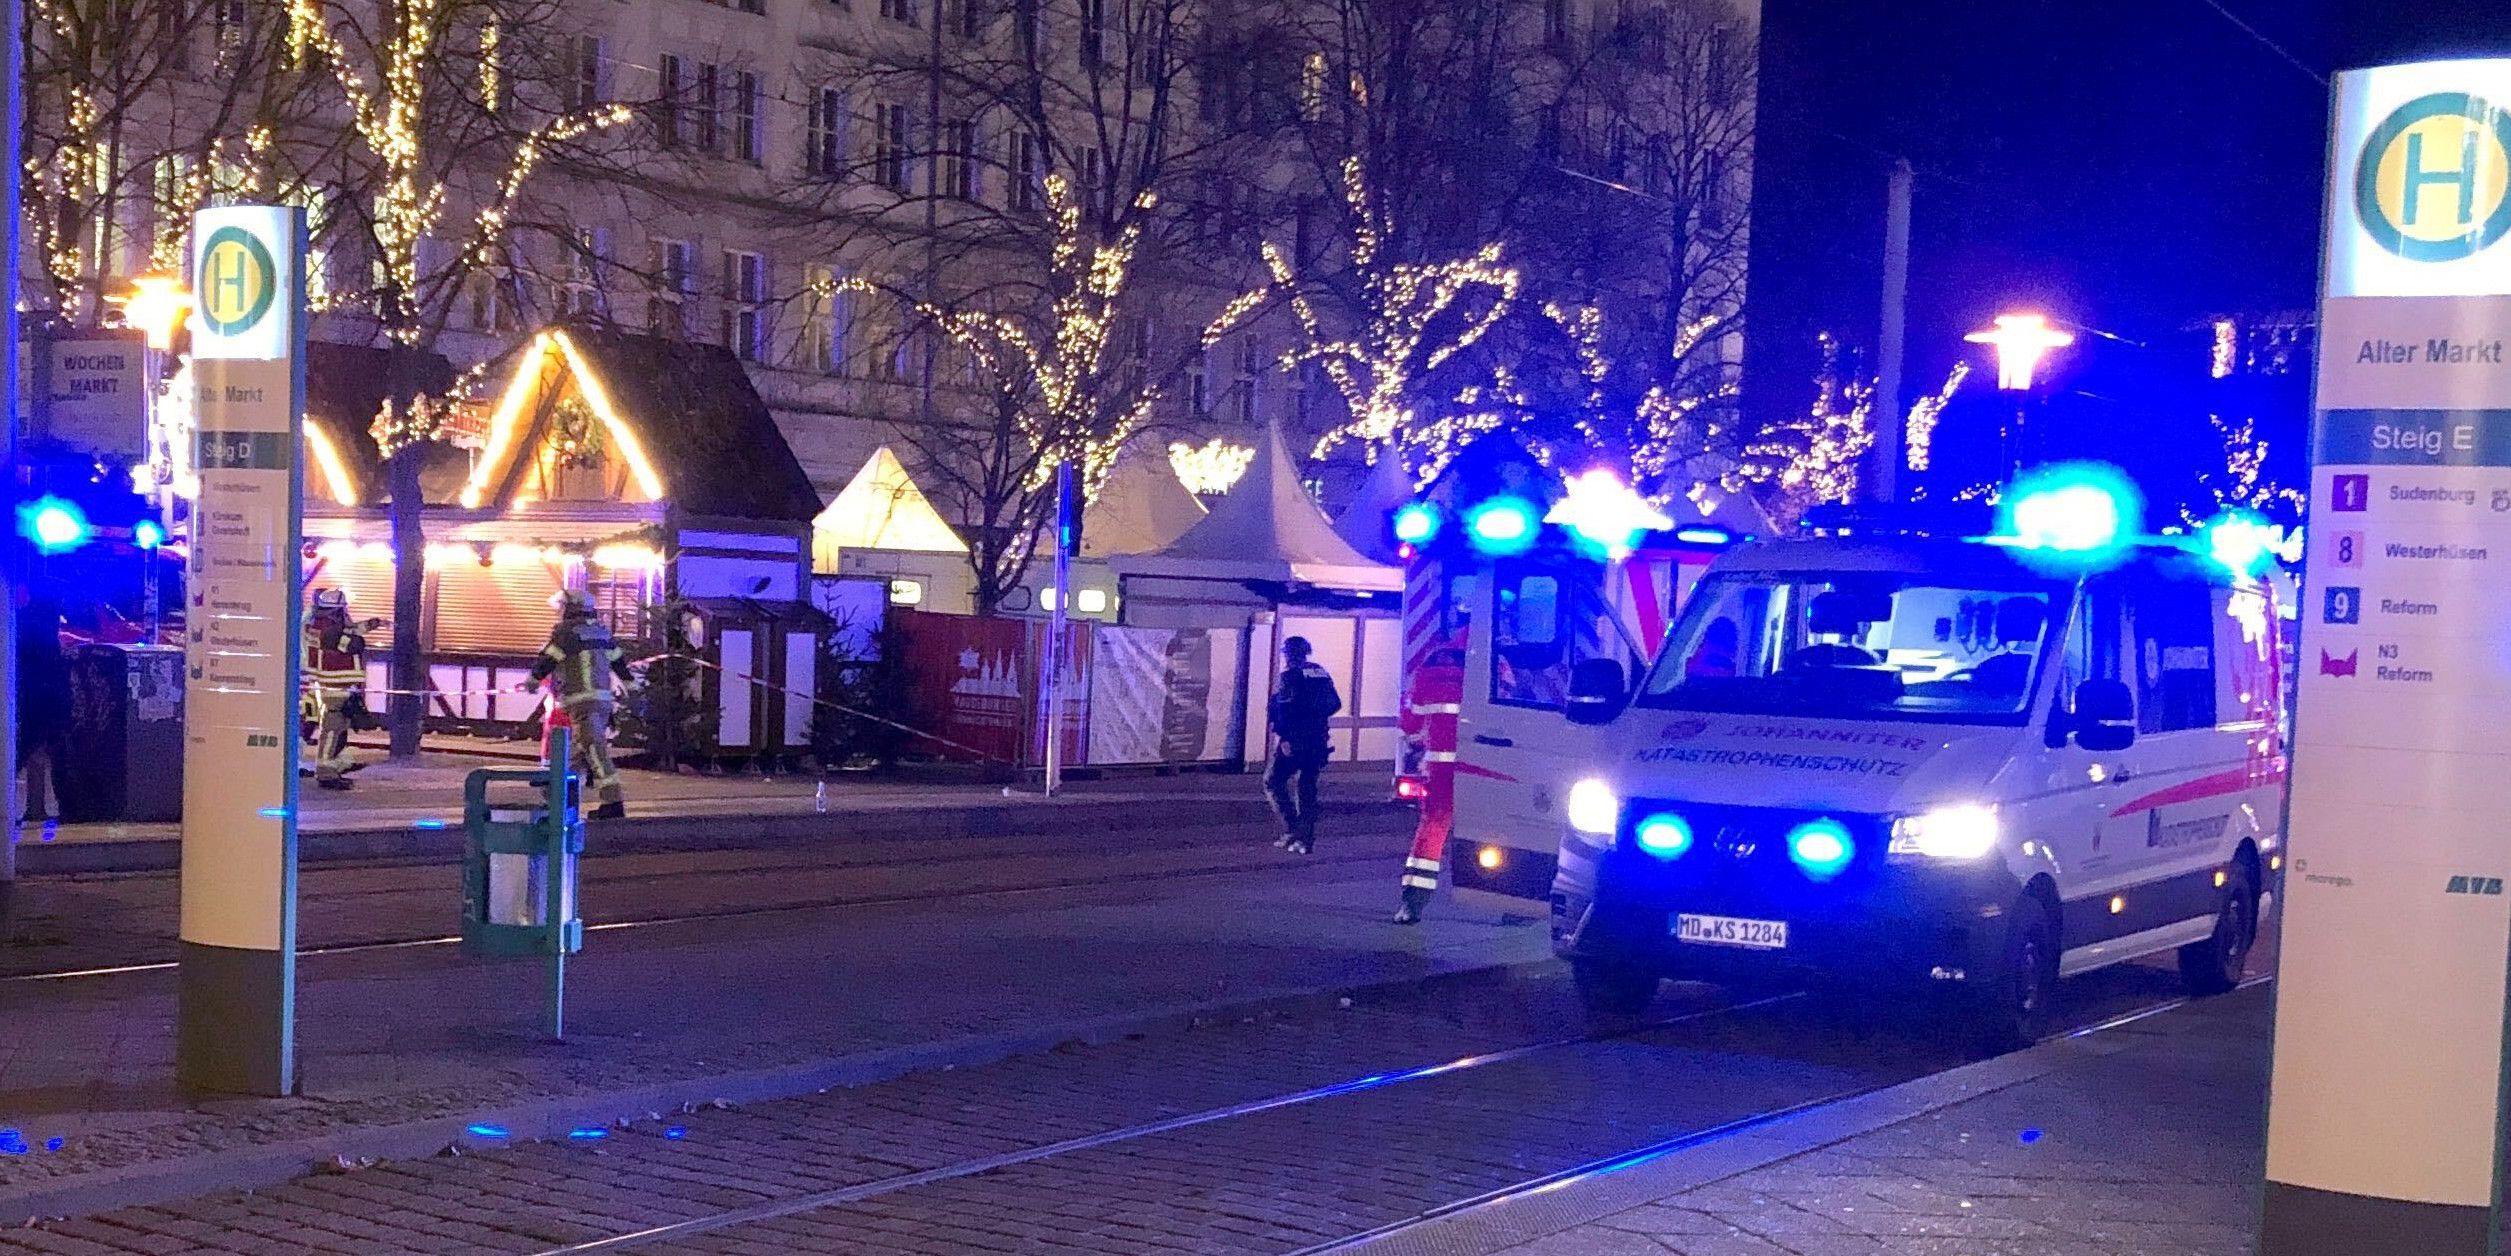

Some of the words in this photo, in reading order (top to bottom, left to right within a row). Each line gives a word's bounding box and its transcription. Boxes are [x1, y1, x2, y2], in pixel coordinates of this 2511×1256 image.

[2402, 132, 2479, 225] H
[213, 251, 246, 313] H
[64, 354, 125, 370] WOCHEN
[2356, 339, 2418, 364] Alter
[2425, 338, 2502, 364] Markt
[70, 378, 119, 394] MARKT
[225, 385, 263, 402] Markt
[238, 442, 251, 459] D
[2372, 424, 2442, 455] Steig
[2453, 425, 2474, 450] E
[2343, 479, 2356, 507] 1
[2390, 485, 2476, 506] Sudenburg
[2339, 536, 2353, 563] 8
[2385, 543, 2487, 560] Westerhüsen
[2334, 592, 2350, 618] 9
[2381, 599, 2437, 615] Reform
[2378, 645, 2398, 659] N3
[2377, 666, 2433, 682] Reform
[1723, 725, 1927, 751] JOHANNITER
[1633, 747, 1908, 776] KATASTROPHENSCHUTZ
[1679, 917, 1701, 938] MD
[1714, 920, 1736, 940] KS
[1740, 922, 1783, 944] 1284
